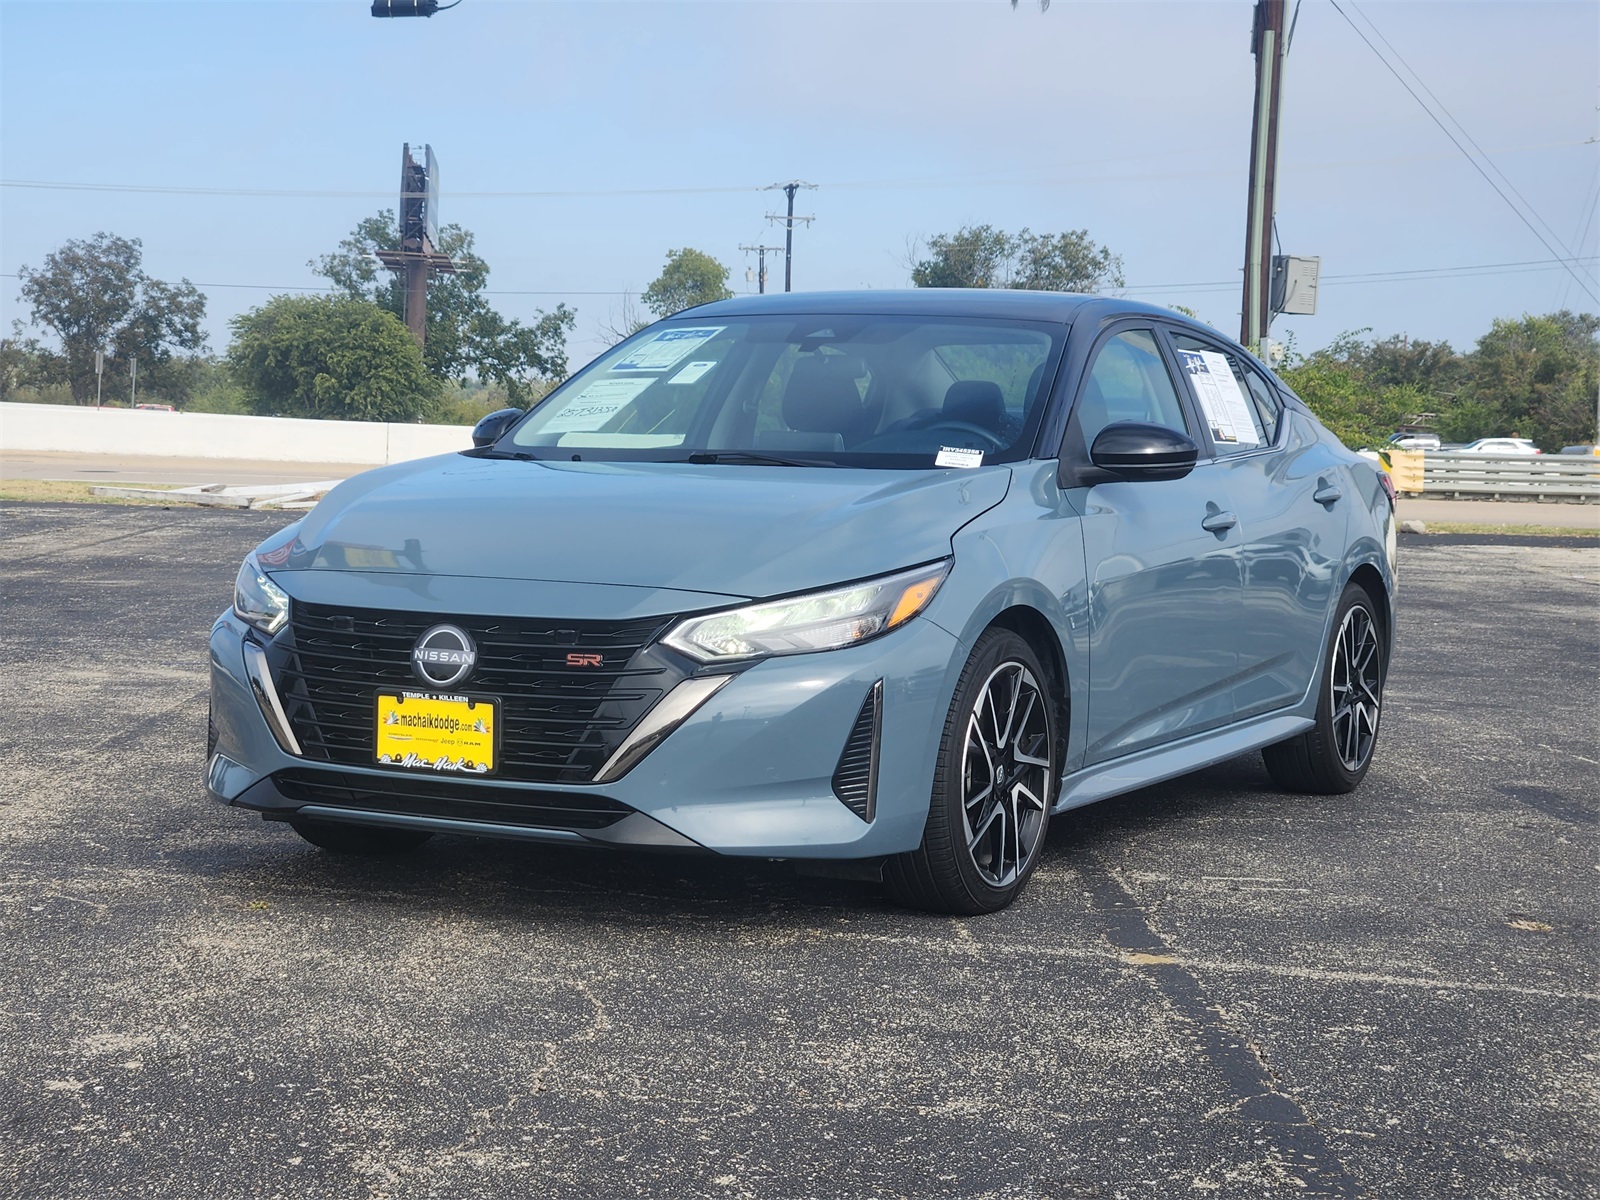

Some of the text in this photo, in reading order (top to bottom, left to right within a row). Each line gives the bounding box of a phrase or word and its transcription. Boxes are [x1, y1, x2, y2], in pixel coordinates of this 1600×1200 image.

[414, 649, 474, 663] NISSAN
[566, 653, 603, 667] SR
[402, 691, 469, 702] TEMPLE KILLEEN
[400, 713, 472, 734] machaikdodge.com
[402, 752, 467, 771] Mac Haik
